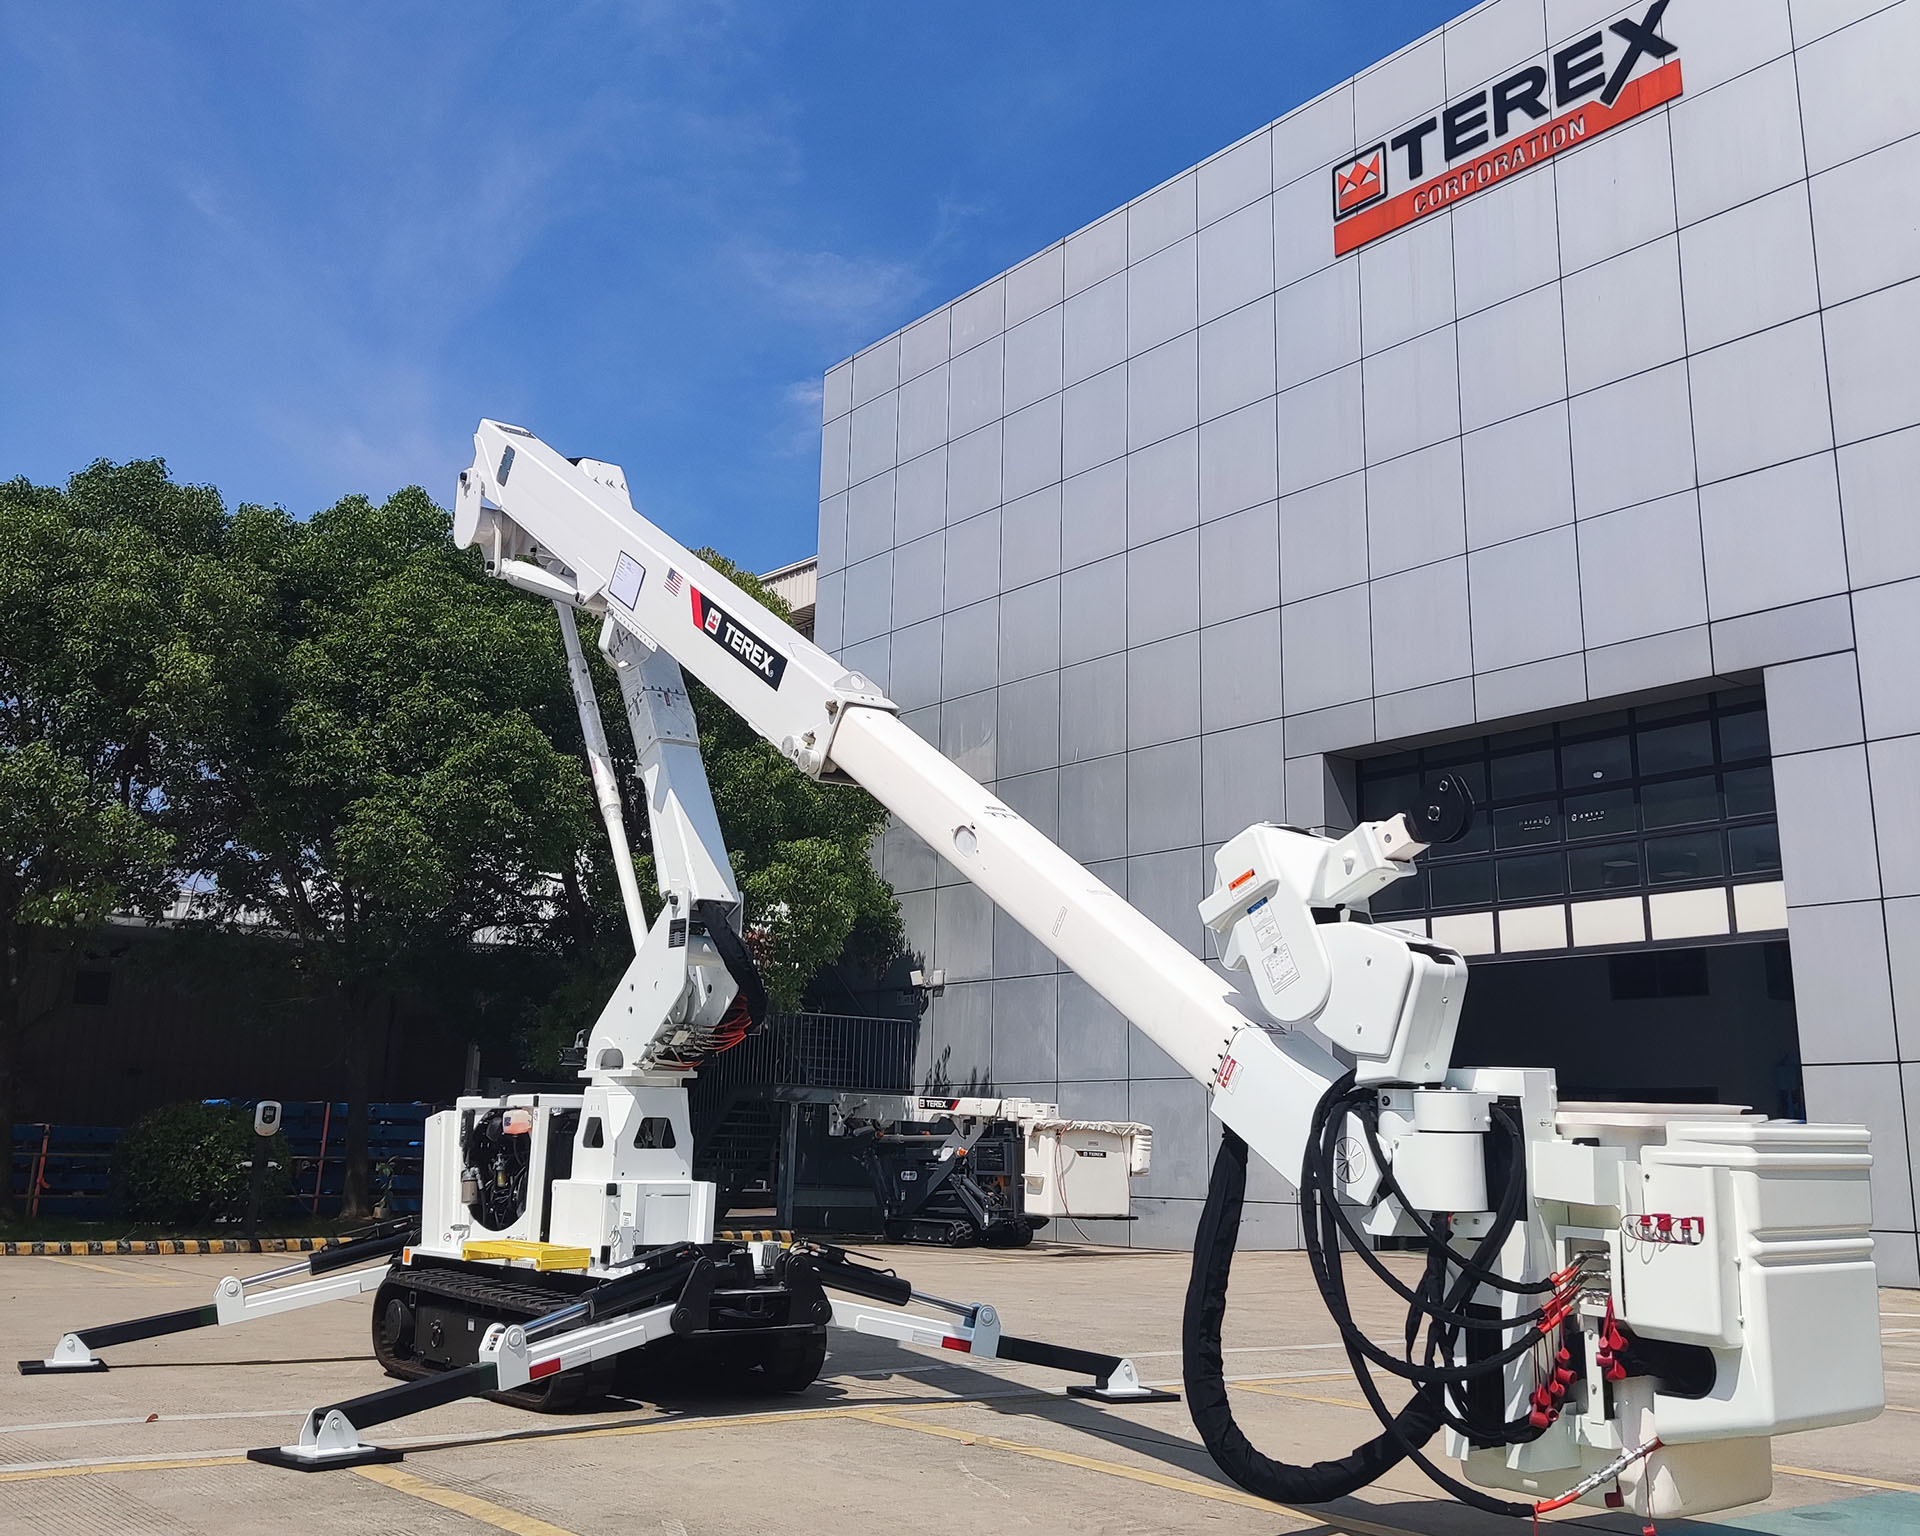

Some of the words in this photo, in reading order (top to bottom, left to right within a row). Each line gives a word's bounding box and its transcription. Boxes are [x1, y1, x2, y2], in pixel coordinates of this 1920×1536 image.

[1390, 0, 1678, 181] TEREX
[1413, 114, 1586, 214] CORPORATION
[724, 621, 775, 677] TEREX
[926, 1100, 948, 1108] TEREX
